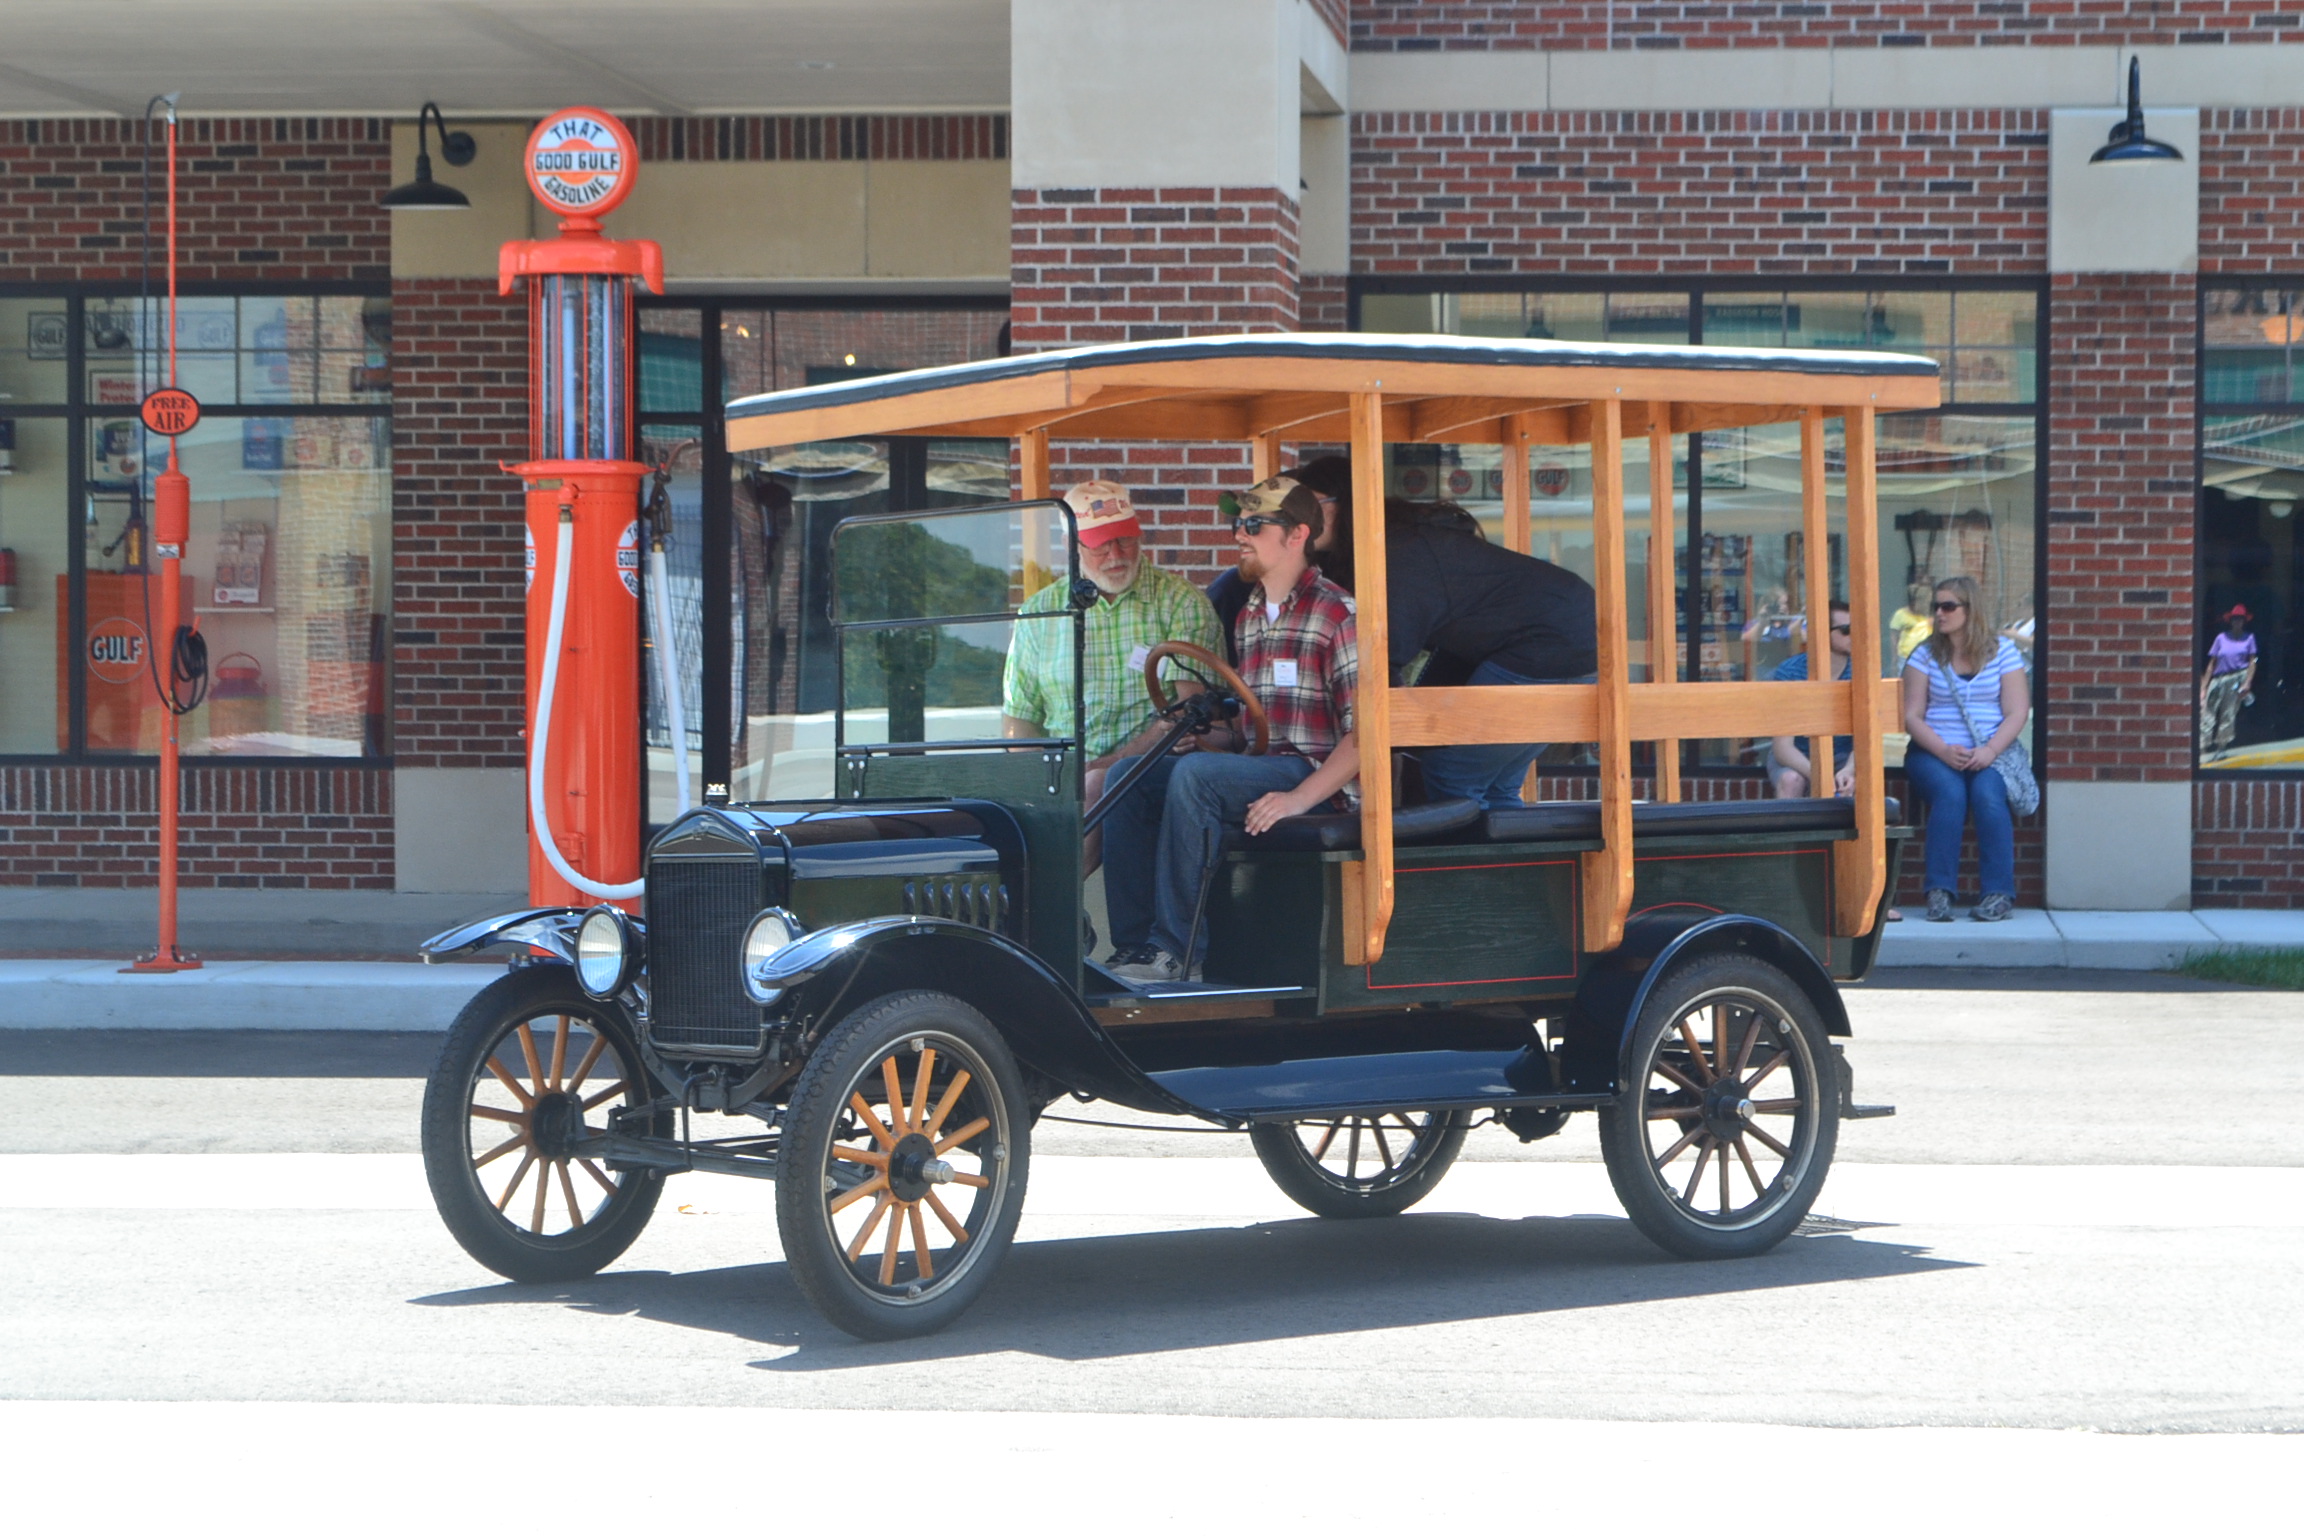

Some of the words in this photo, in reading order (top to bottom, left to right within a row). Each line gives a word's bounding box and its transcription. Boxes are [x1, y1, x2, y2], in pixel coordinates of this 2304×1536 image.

[549, 120, 603, 141] THAT
[535, 153, 573, 171] GOOD
[578, 153, 619, 171] GULF
[544, 176, 610, 203] GASOLINE
[150, 397, 191, 409] FREE
[154, 411, 186, 430] AIR
[1537, 470, 1566, 485] GULF
[91, 635, 143, 664] GULF
